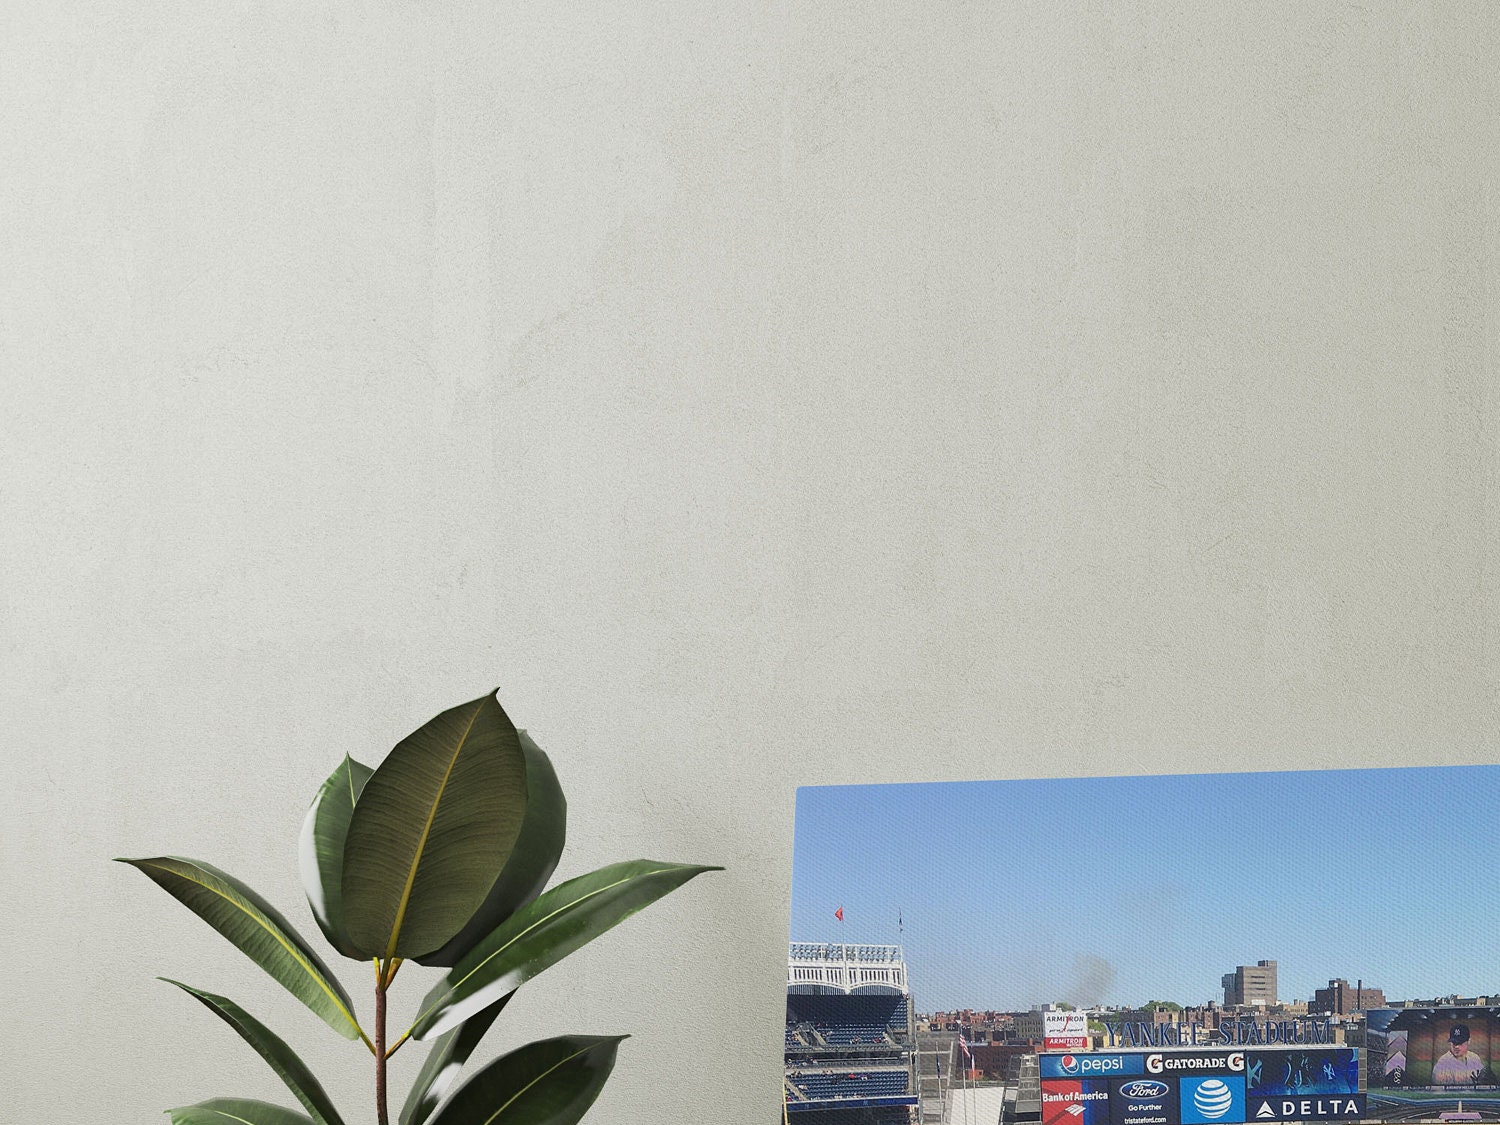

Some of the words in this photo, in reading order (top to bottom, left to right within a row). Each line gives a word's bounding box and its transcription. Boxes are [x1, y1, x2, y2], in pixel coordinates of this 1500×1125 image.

[1103, 1021, 1204, 1047] YANKEE
[1218, 1020, 1333, 1045] STADIUM
[1081, 1056, 1123, 1073] pepsi
[1164, 1058, 1226, 1069] GATORADE
[1042, 1092, 1064, 1102] Bank
[1074, 1091, 1108, 1101] America
[1129, 1082, 1159, 1096] Ford
[1282, 1100, 1359, 1116] DELTA
